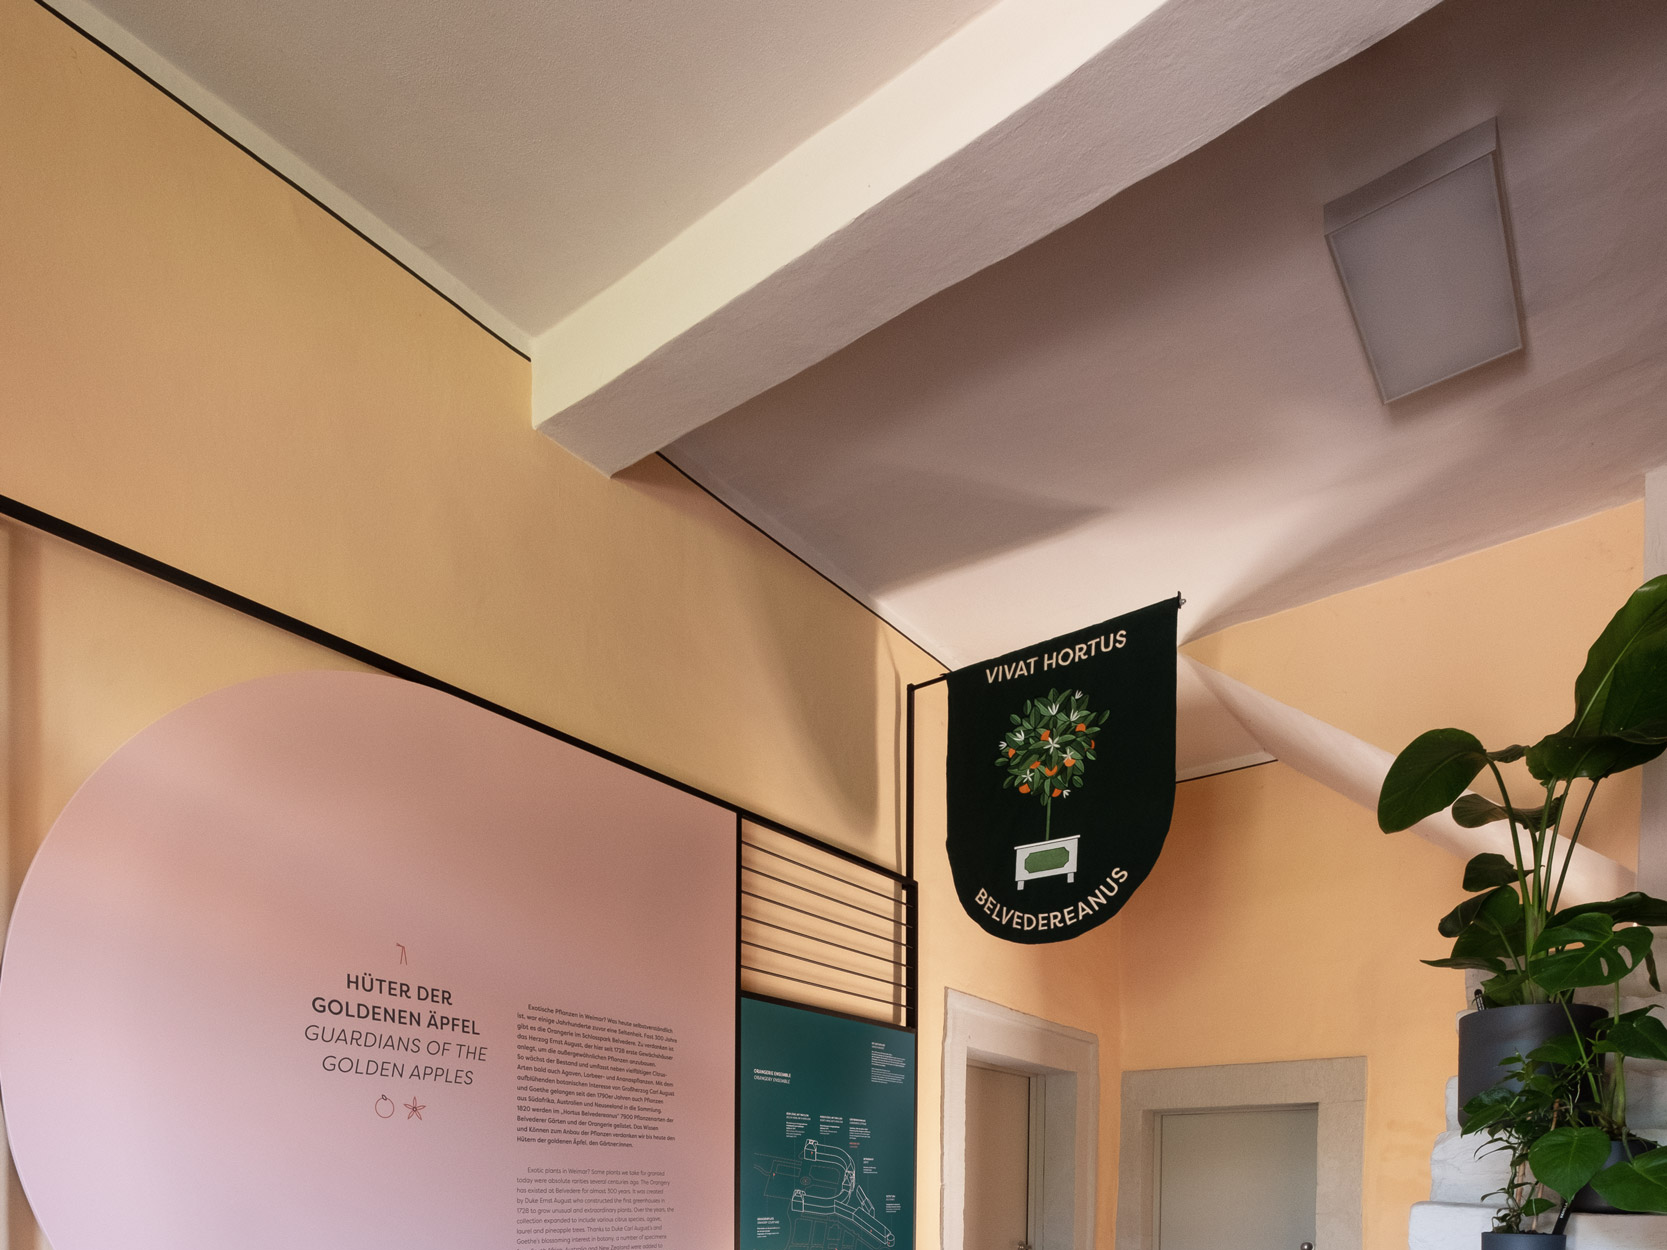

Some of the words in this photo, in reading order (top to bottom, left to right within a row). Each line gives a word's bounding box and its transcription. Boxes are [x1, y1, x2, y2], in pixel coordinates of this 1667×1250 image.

[985, 656, 1038, 684] VIVAT
[1043, 630, 1127, 670] HORTUS
[974, 867, 1129, 931] BELVEDEREANUS
[346, 973, 411, 999] HÜTER
[417, 985, 453, 1005] DER
[312, 997, 420, 1026] GOLDENEN
[427, 1011, 480, 1035] ÄPFEL
[528, 1004, 554, 1013] Exotische
[555, 1008, 578, 1017] Pflanzen
[538, 1016, 554, 1025] einige
[547, 1027, 573, 1037] Orangerie
[304, 1024, 421, 1053] GUARDIANS
[426, 1040, 451, 1056] OF
[456, 1043, 488, 1062] THE
[528, 1034, 548, 1044] Herzog
[549, 1037, 563, 1045] Ernst
[322, 1055, 405, 1078] GOLDEN
[409, 1065, 474, 1085] APPLES
[517, 1074, 555, 1083] aufblühenden
[529, 1085, 549, 1093] Goethe
[550, 1088, 575, 1096] gelangen
[516, 1115, 546, 1123] Belvederer
